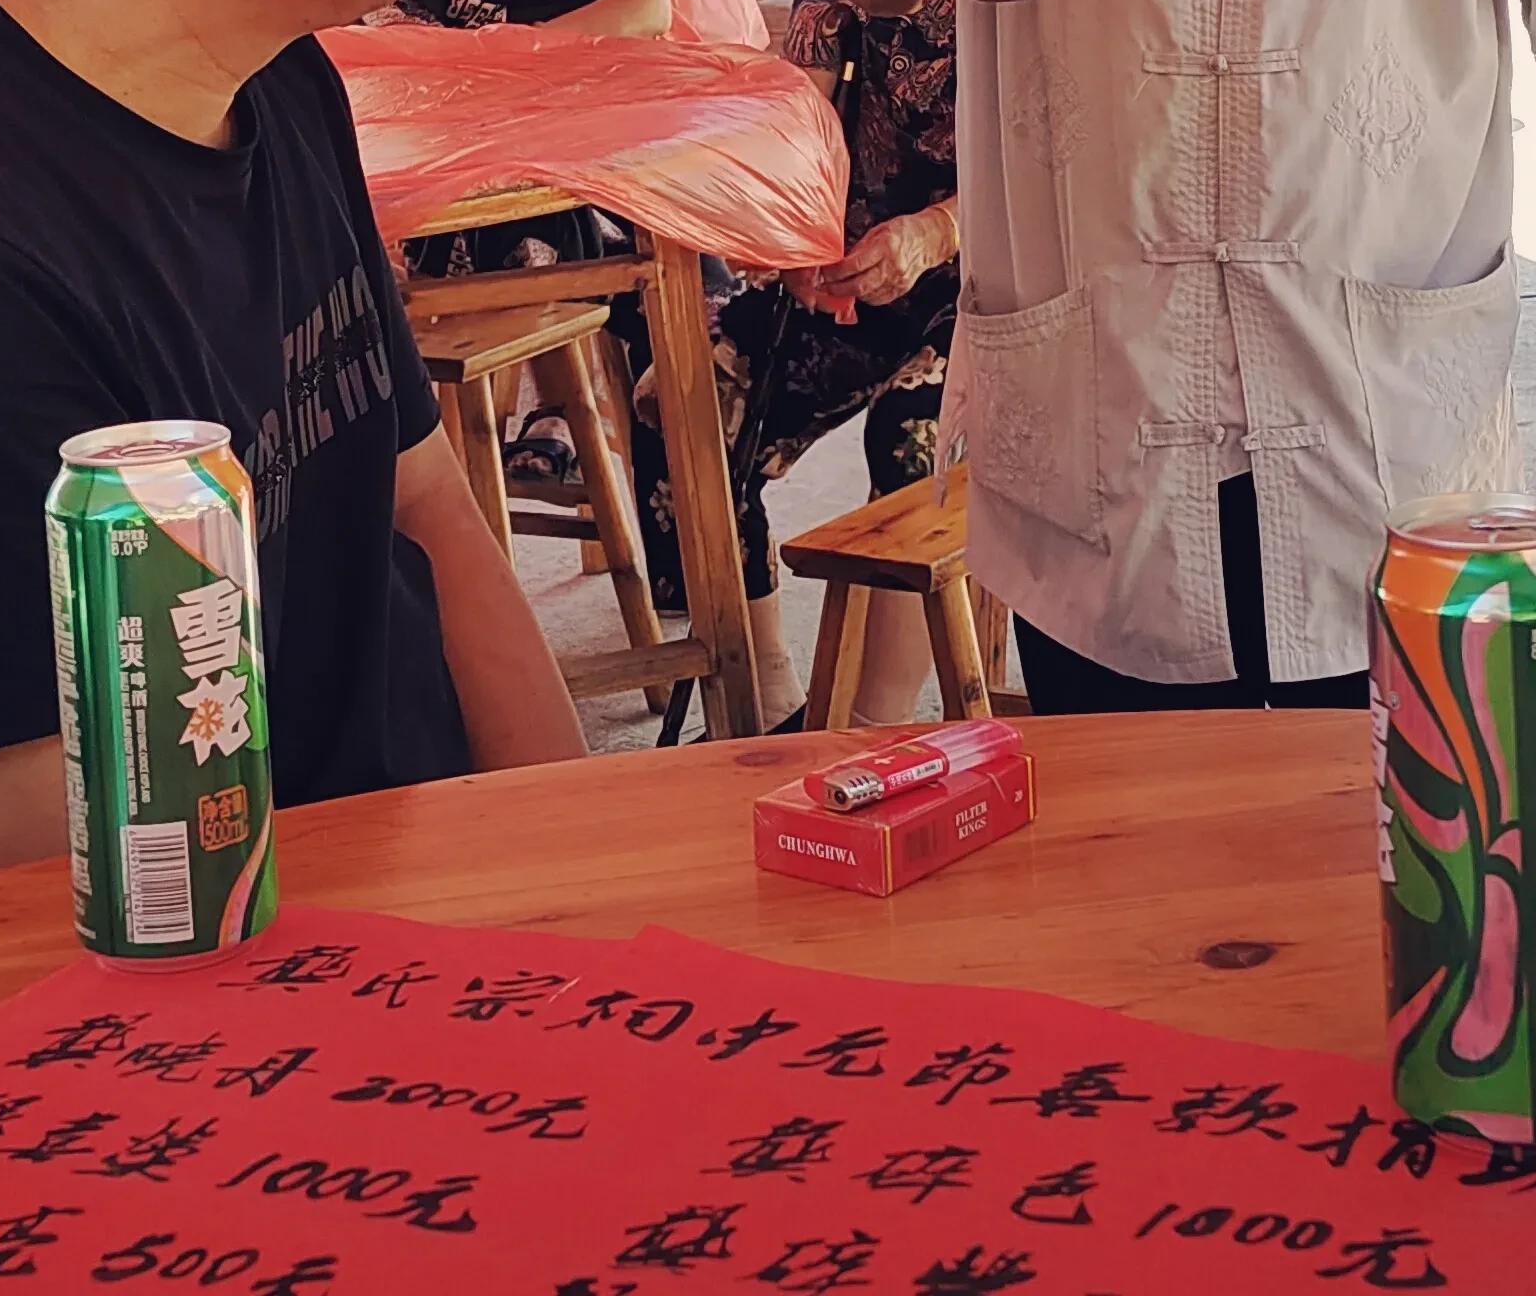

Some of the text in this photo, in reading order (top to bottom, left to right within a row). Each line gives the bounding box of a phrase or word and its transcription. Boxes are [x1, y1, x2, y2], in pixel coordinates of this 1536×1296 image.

[169, 577, 252, 767] 雪花
[955, 801, 988, 827] FILTER
[958, 816, 987, 841] KINGS
[778, 834, 857, 866] CHUNGHWA
[216, 1152, 482, 1234] 1000元
[1135, 1203, 1448, 1289] 1000元
